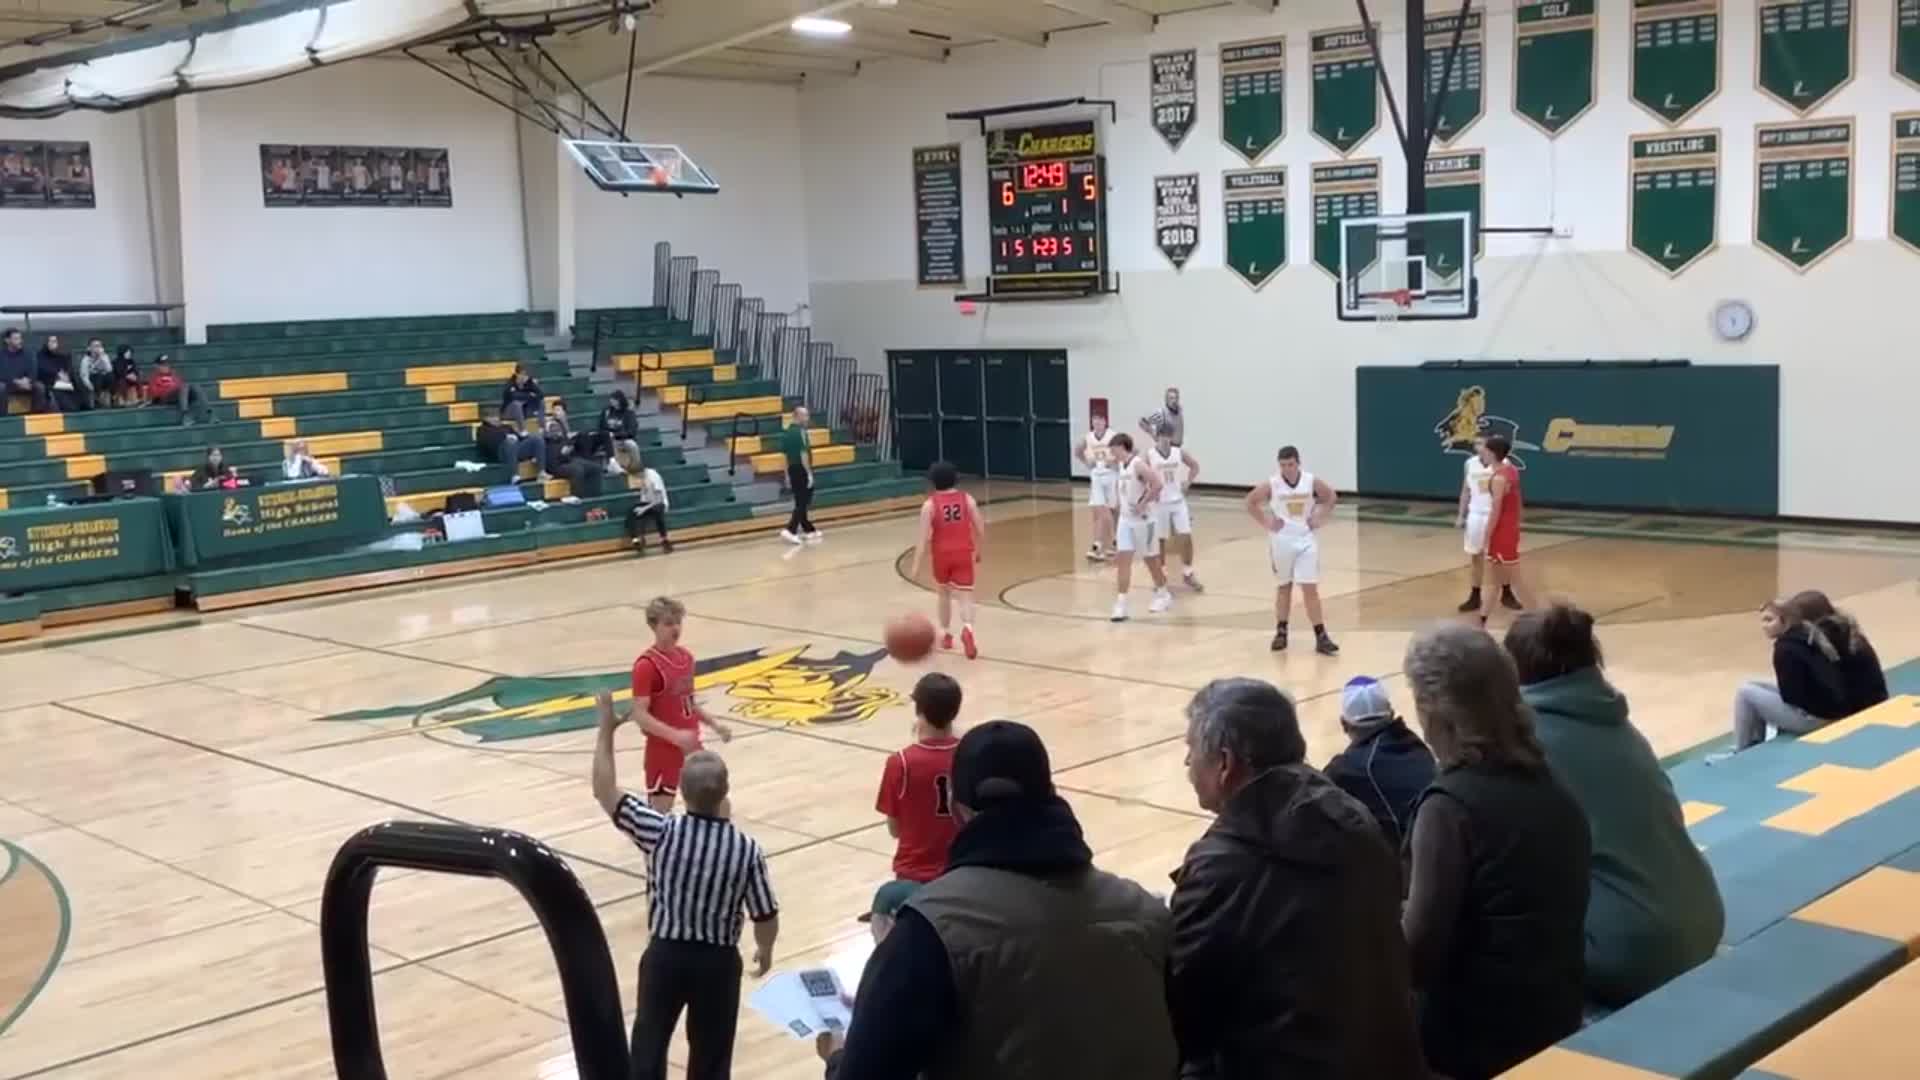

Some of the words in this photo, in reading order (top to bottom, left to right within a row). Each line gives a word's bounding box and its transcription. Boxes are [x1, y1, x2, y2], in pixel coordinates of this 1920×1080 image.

[1541, 3, 1569, 17] GOLF
[1157, 106, 1190, 124] 2017
[1646, 138, 1705, 154] WRESTLING
[1023, 163, 1065, 188] 12:49
[1002, 181, 1014, 206] 6
[1083, 174, 1095, 200] 5
[1001, 241, 1007, 257] 1
[1014, 239, 1025, 257] 5
[1062, 236, 1072, 256] 5
[1088, 236, 1094, 252] 1
[284, 511, 338, 528] CHARGERS
[943, 504, 961, 522] 32
[28, 538, 65, 554] High
[69, 533, 120, 548] School
[56, 547, 120, 564] CHARGERS
